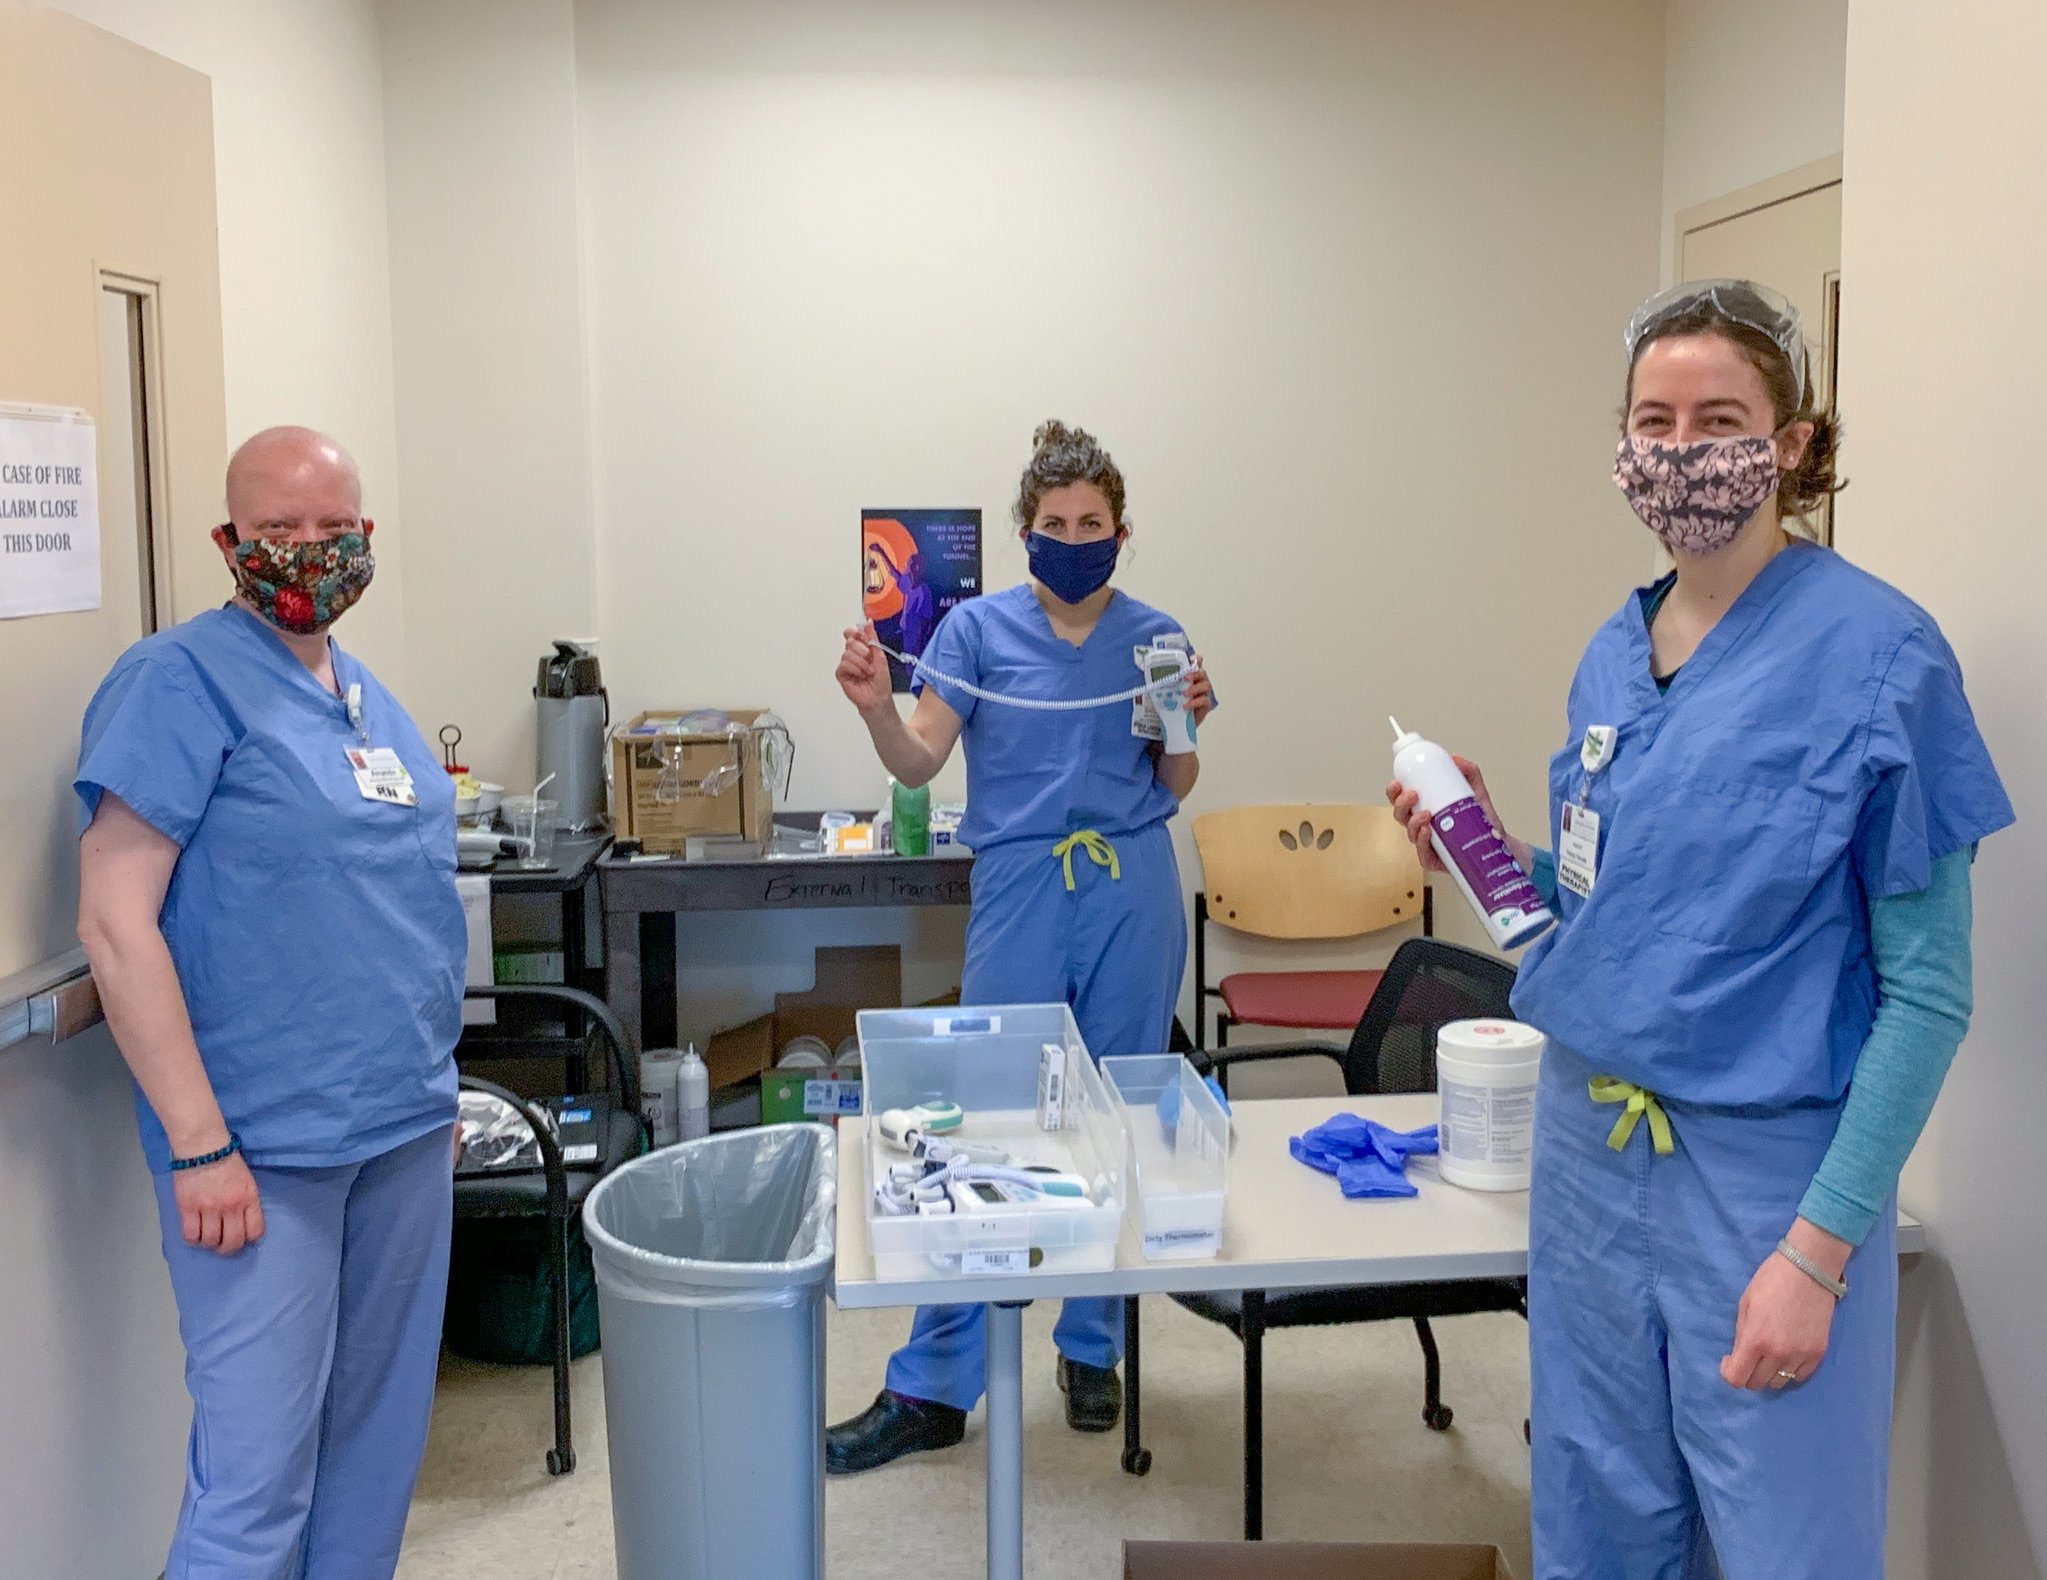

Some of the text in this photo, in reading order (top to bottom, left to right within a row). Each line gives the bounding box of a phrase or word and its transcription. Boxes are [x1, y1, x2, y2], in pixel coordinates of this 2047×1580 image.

[3, 464, 82, 486] CASE OF FIRE
[0, 499, 78, 518] LARM CLOSE
[3, 533, 71, 553] THIS DOOR
[952, 543, 976, 551] OF THE
[960, 577, 976, 589] WE
[1144, 1232, 1162, 1244] Dirty
